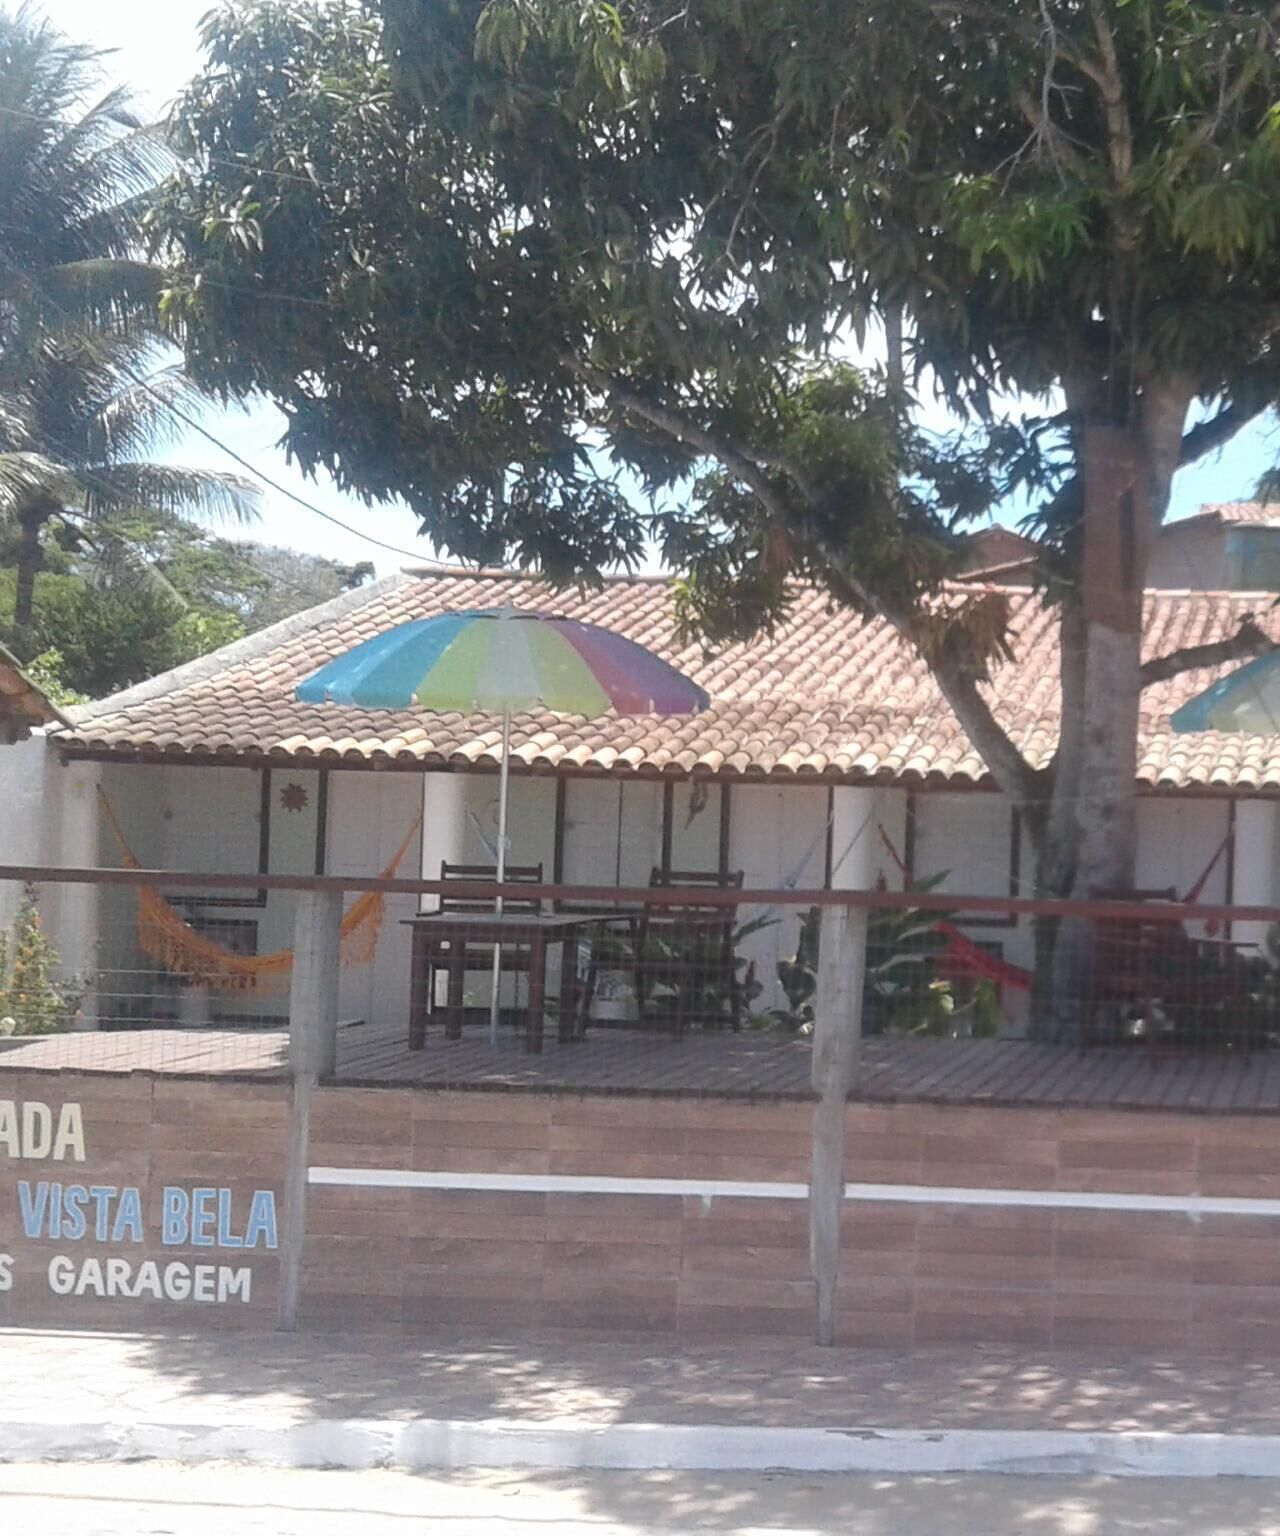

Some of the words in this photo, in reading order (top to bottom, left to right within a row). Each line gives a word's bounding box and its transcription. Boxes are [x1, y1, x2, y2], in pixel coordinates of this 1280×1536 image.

[0, 1100, 85, 1161] ADA
[17, 1181, 144, 1243] VISTA
[162, 1186, 278, 1249] BELA
[48, 1255, 251, 1302] GARAGEM
